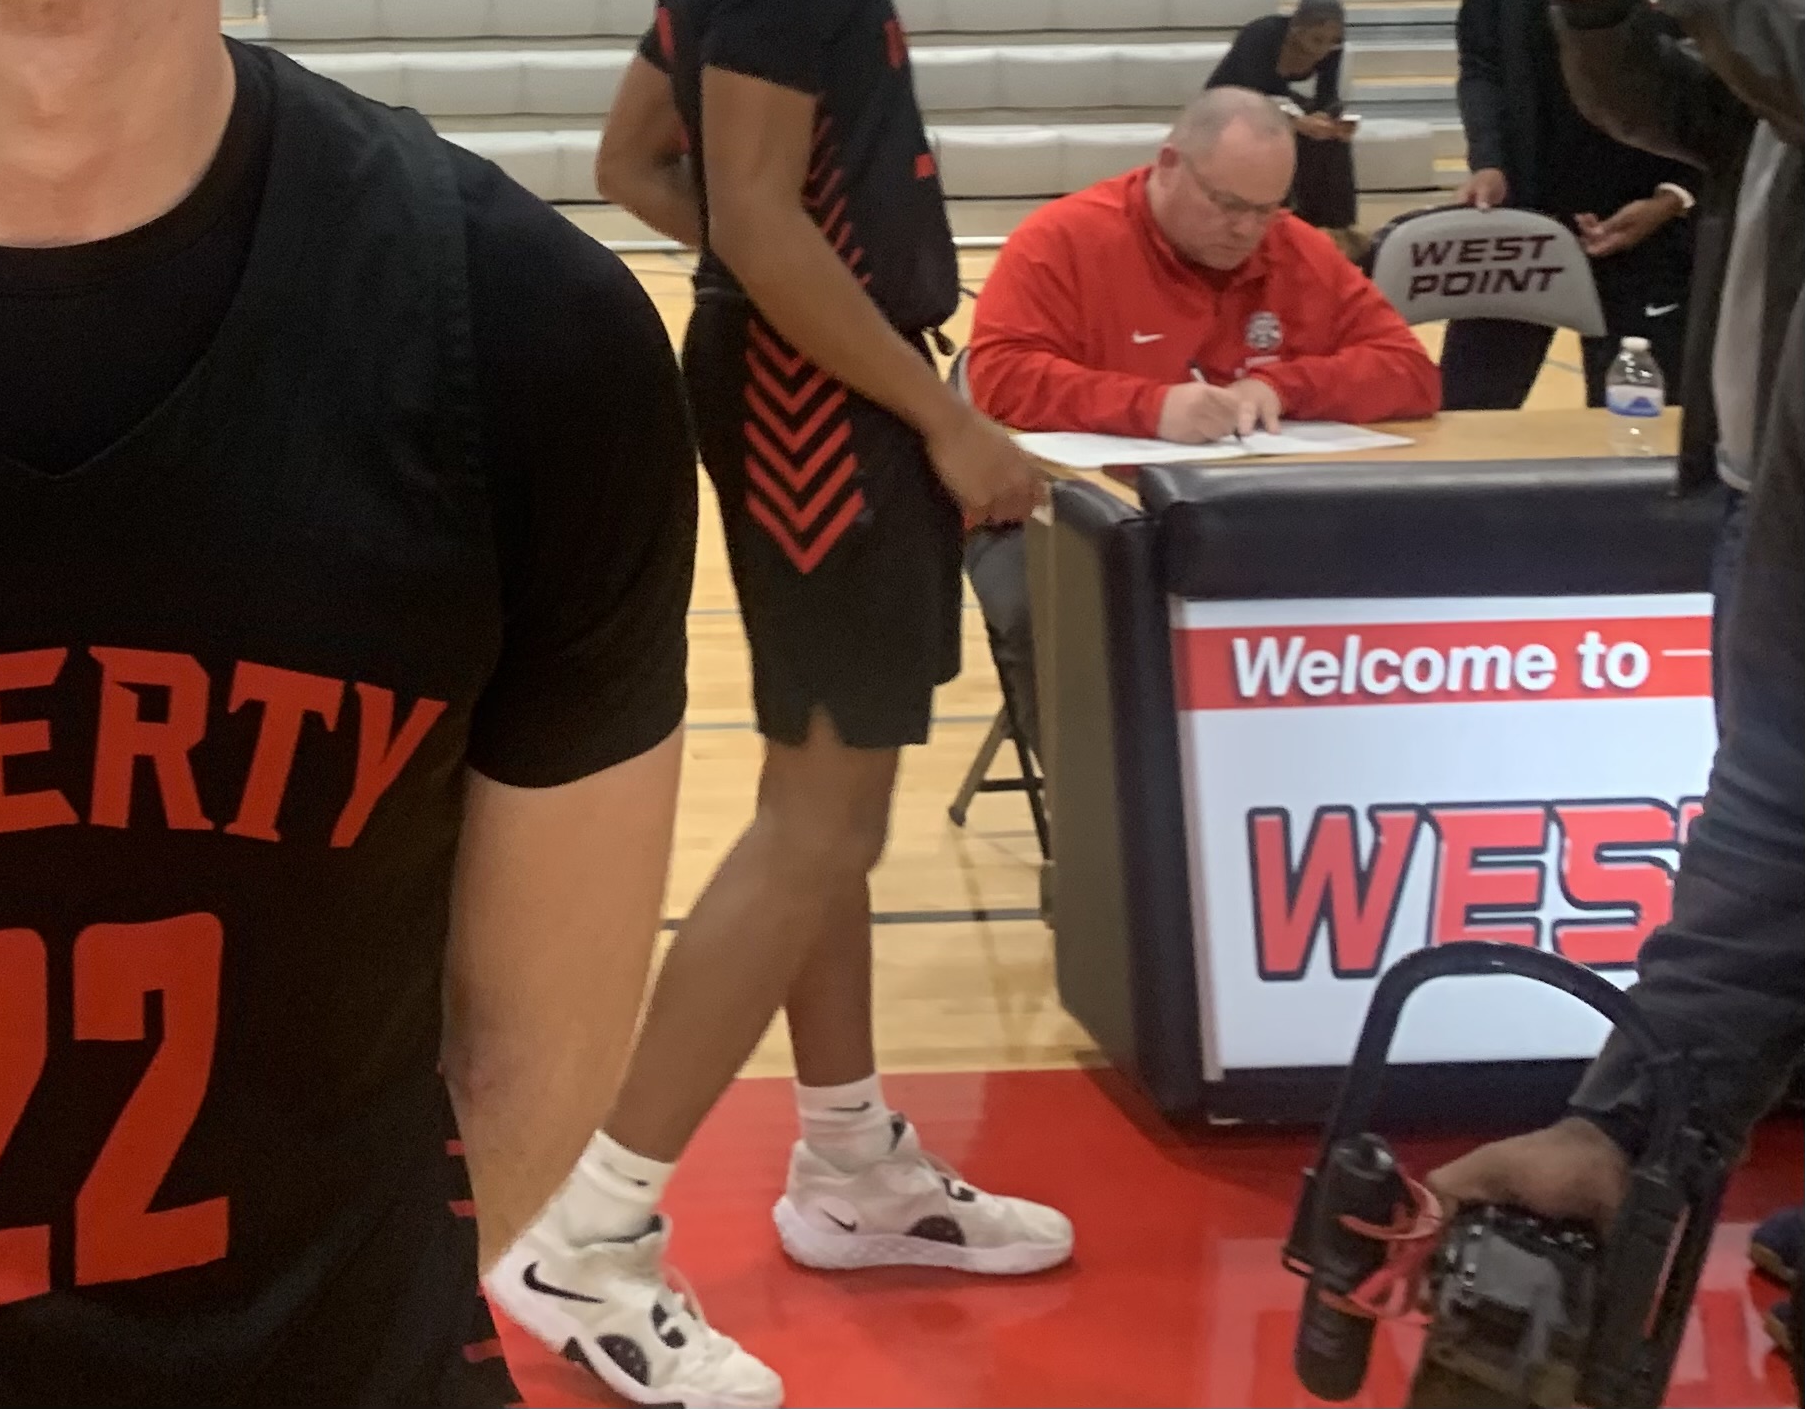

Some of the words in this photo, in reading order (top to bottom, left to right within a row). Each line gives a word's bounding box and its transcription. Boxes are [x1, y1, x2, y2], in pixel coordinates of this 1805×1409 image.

[1410, 234, 1558, 268] WEST
[1406, 266, 1566, 302] POINT
[1232, 633, 1559, 699] Welcome
[1576, 630, 1651, 691] to
[1247, 795, 1706, 982] WES
